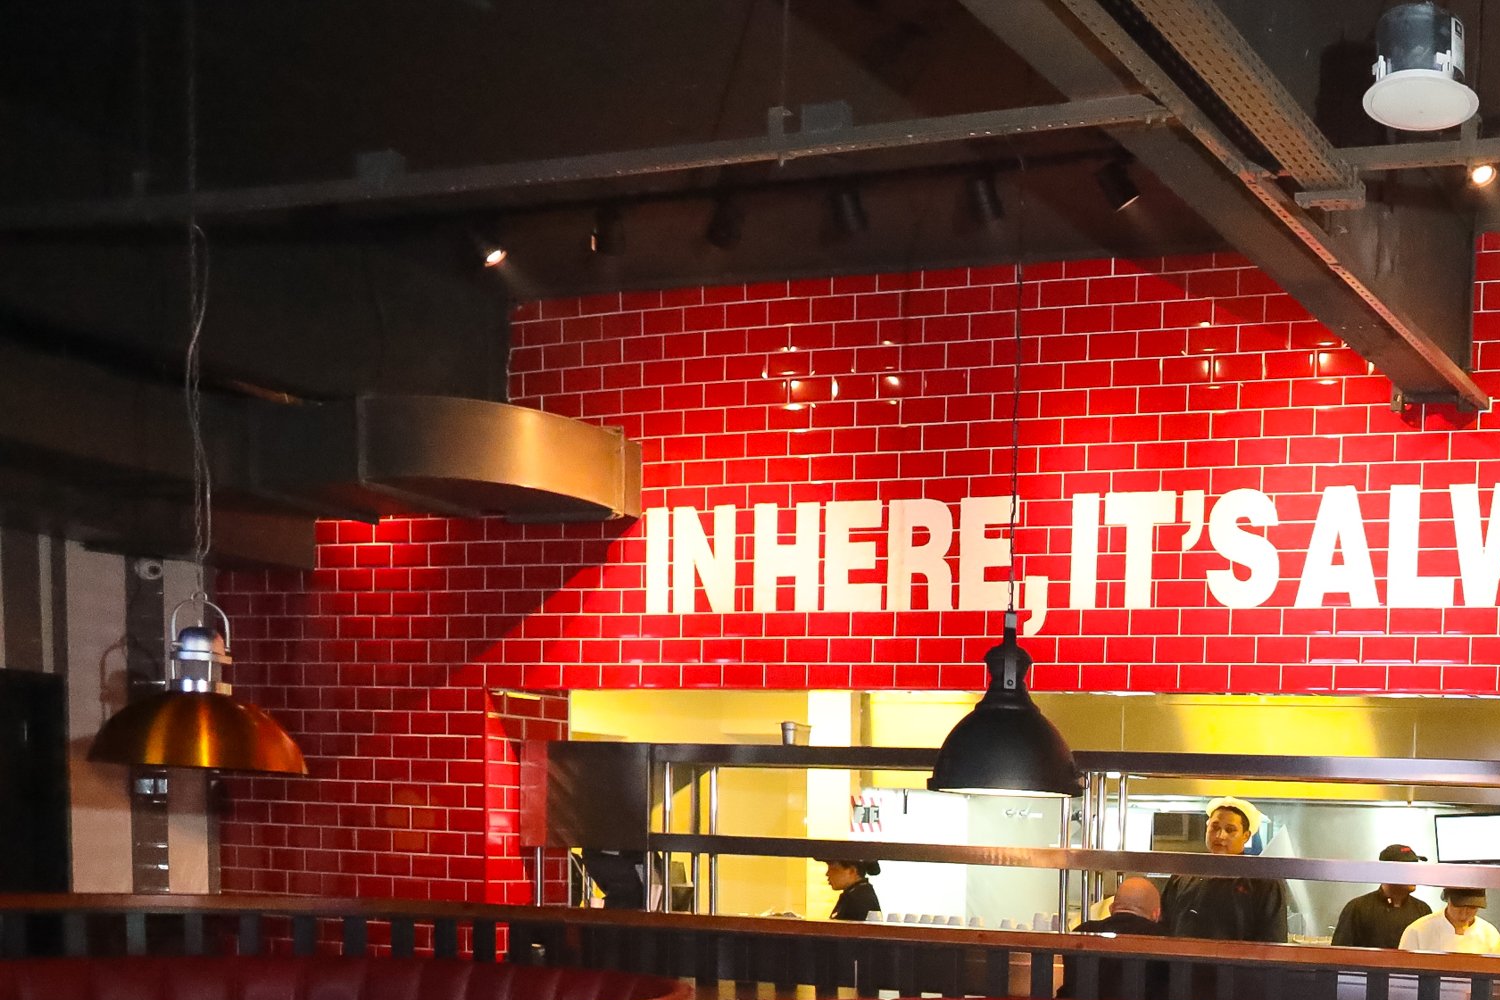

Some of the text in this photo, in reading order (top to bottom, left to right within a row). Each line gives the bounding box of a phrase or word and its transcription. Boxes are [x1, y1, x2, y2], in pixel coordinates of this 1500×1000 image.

[645, 505, 736, 614] IN
[754, 495, 1048, 637] HERE,
[1069, 488, 1279, 610] IT'S
